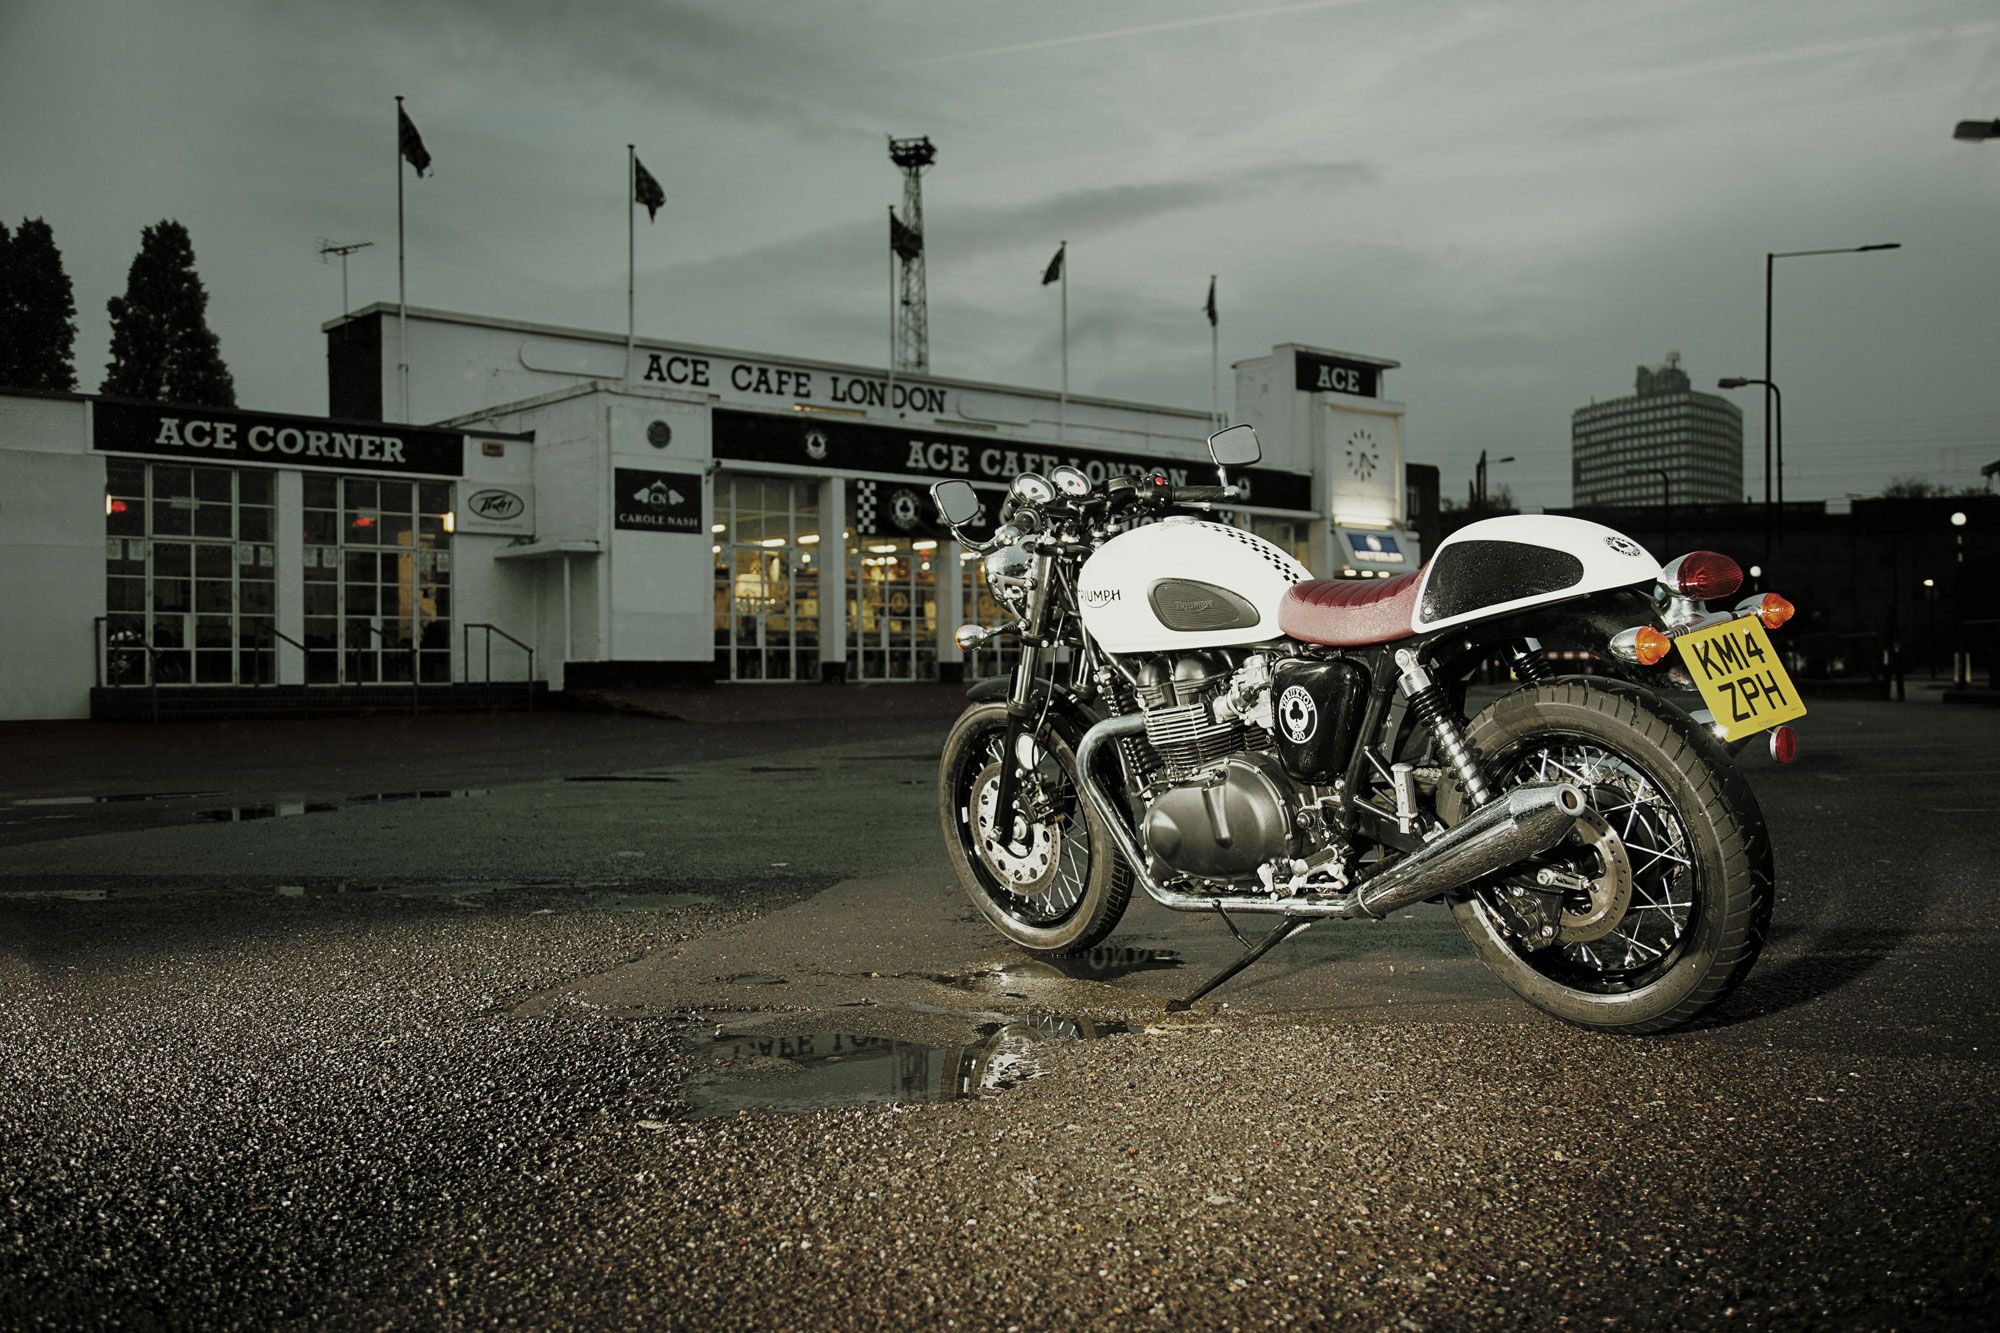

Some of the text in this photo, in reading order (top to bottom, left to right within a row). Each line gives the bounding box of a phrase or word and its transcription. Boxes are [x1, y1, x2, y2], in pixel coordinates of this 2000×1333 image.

[643, 354, 948, 414] ACE CAFE LONDON
[1316, 364, 1361, 393] ACE
[155, 416, 406, 463] ACE CORNER
[906, 440, 970, 473] ACE
[980, 448, 1060, 480] CAFE
[619, 512, 698, 527] CAROLE NASH
[1174, 599, 1215, 612] TRIUMPH
[1691, 631, 1767, 681] KM14
[1280, 688, 1315, 711] THRUXTON
[1717, 670, 1788, 723] ZPH
